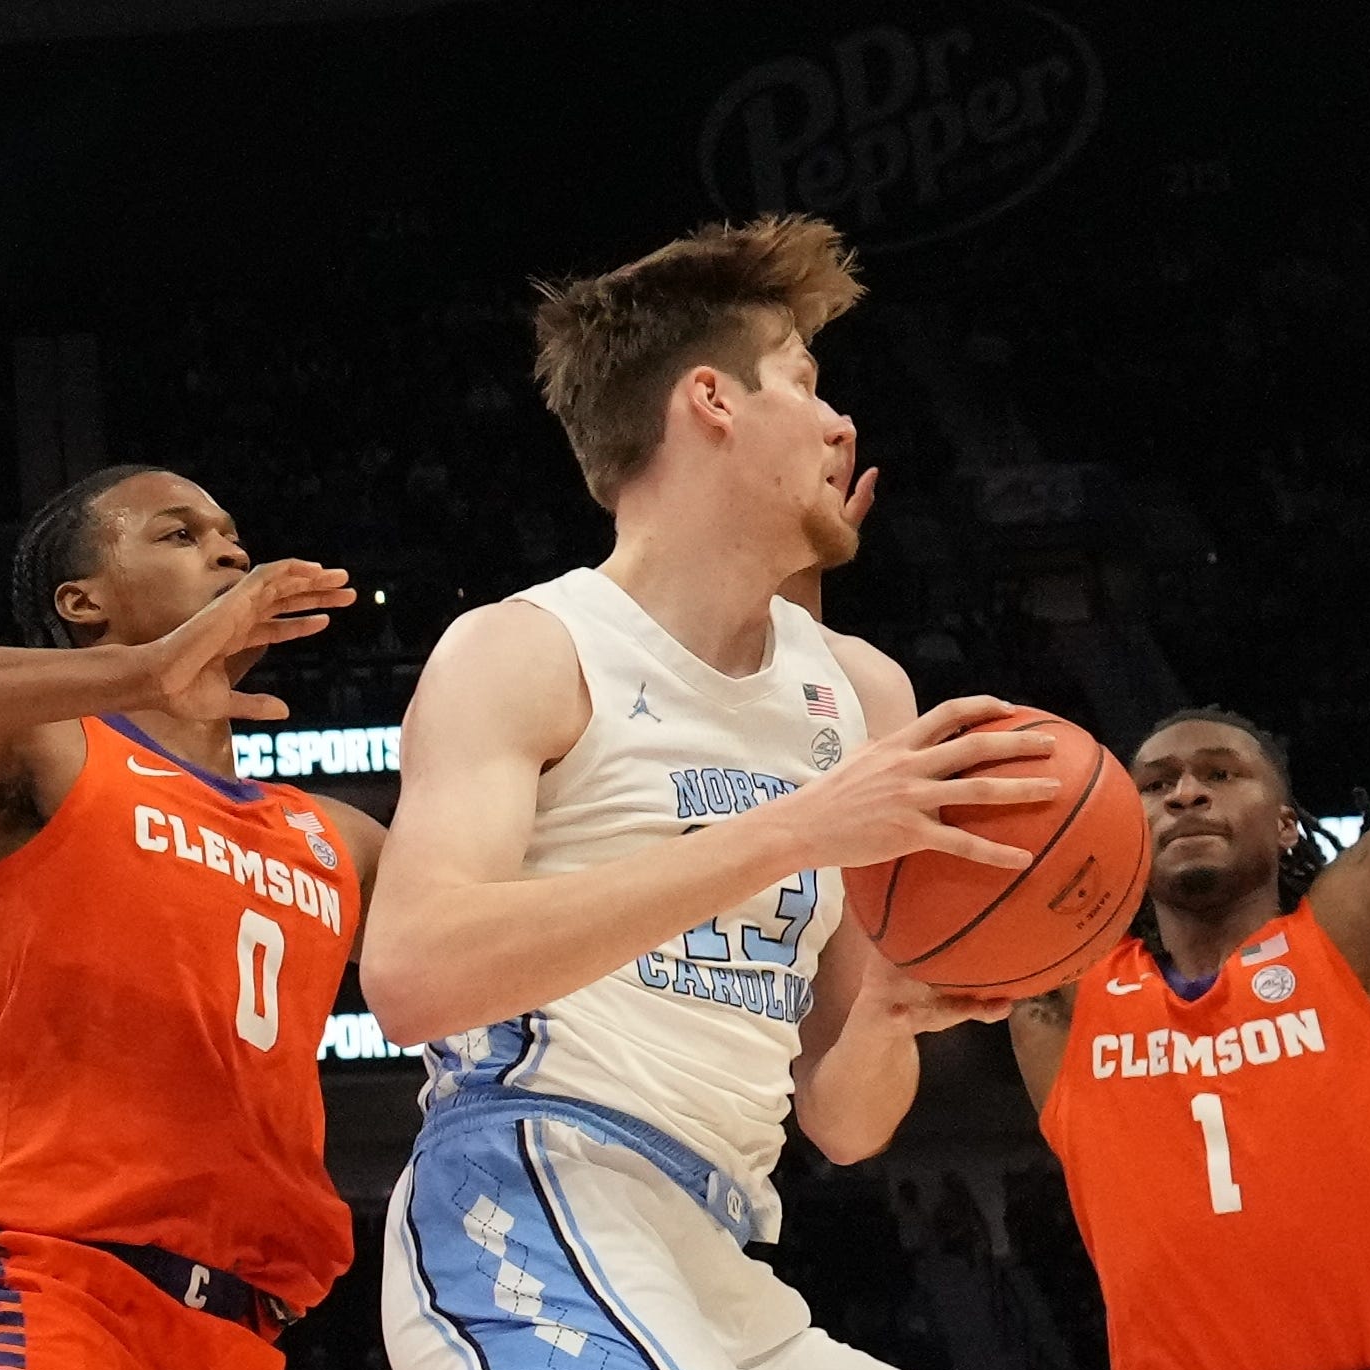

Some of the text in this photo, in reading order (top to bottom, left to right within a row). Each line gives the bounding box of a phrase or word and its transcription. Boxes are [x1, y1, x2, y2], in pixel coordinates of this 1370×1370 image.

[835, 25, 974, 133] Dr
[716, 55, 1072, 225] Pepper
[231, 726, 401, 779] CC SPORTS
[669, 768, 805, 819] NORT
[133, 803, 342, 936] CLEMSON
[235, 907, 285, 1053] 0
[1091, 1007, 1327, 1080] CLEMSON
[1190, 1092, 1243, 1215] 1
[183, 1263, 211, 1310] C
